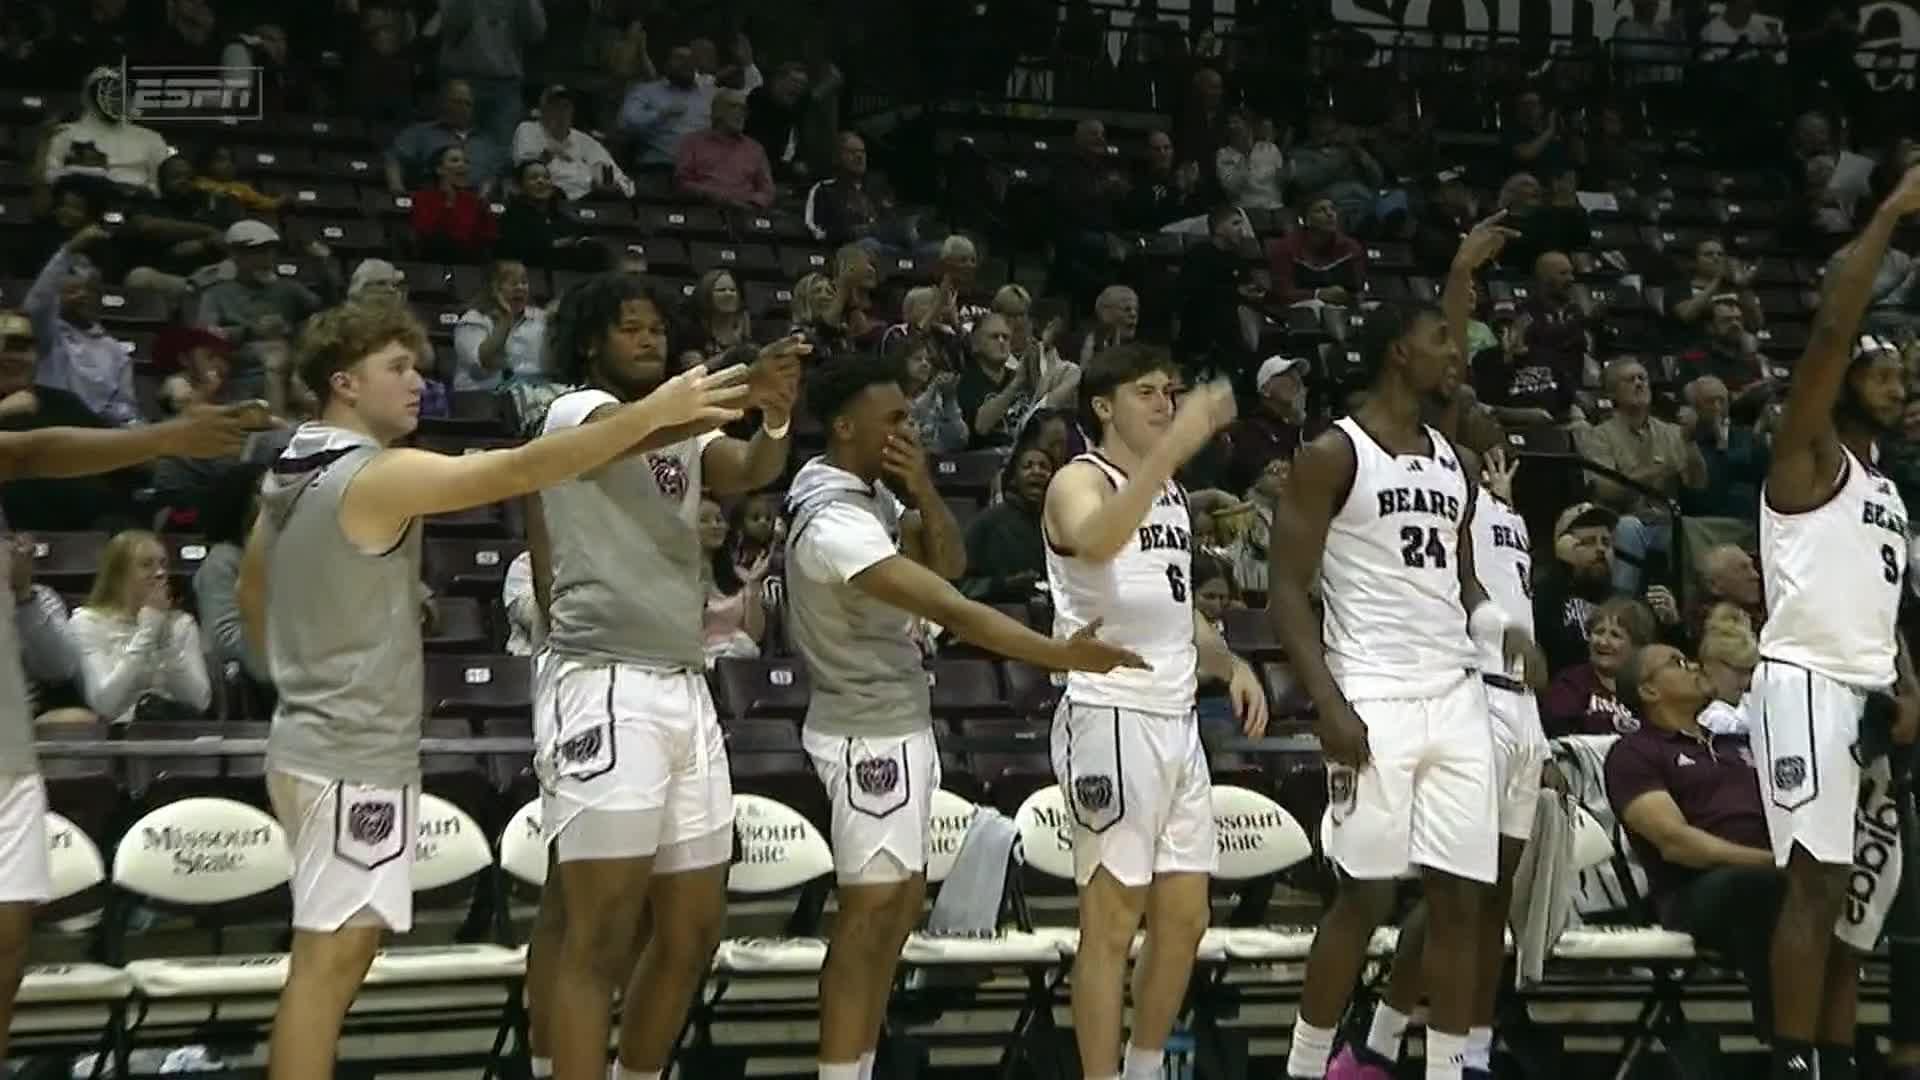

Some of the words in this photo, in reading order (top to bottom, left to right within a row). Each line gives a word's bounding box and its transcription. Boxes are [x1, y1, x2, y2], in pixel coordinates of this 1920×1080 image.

[1377, 486, 1460, 523] BEARS
[1863, 500, 1906, 539] BEA
[1138, 523, 1189, 553] BEAR
[1400, 525, 1448, 569] 24
[1491, 523, 1532, 552] BEA
[1165, 562, 1187, 603] 6
[1881, 543, 1898, 585] 9
[142, 824, 271, 850] Missouri
[173, 847, 247, 875] State
